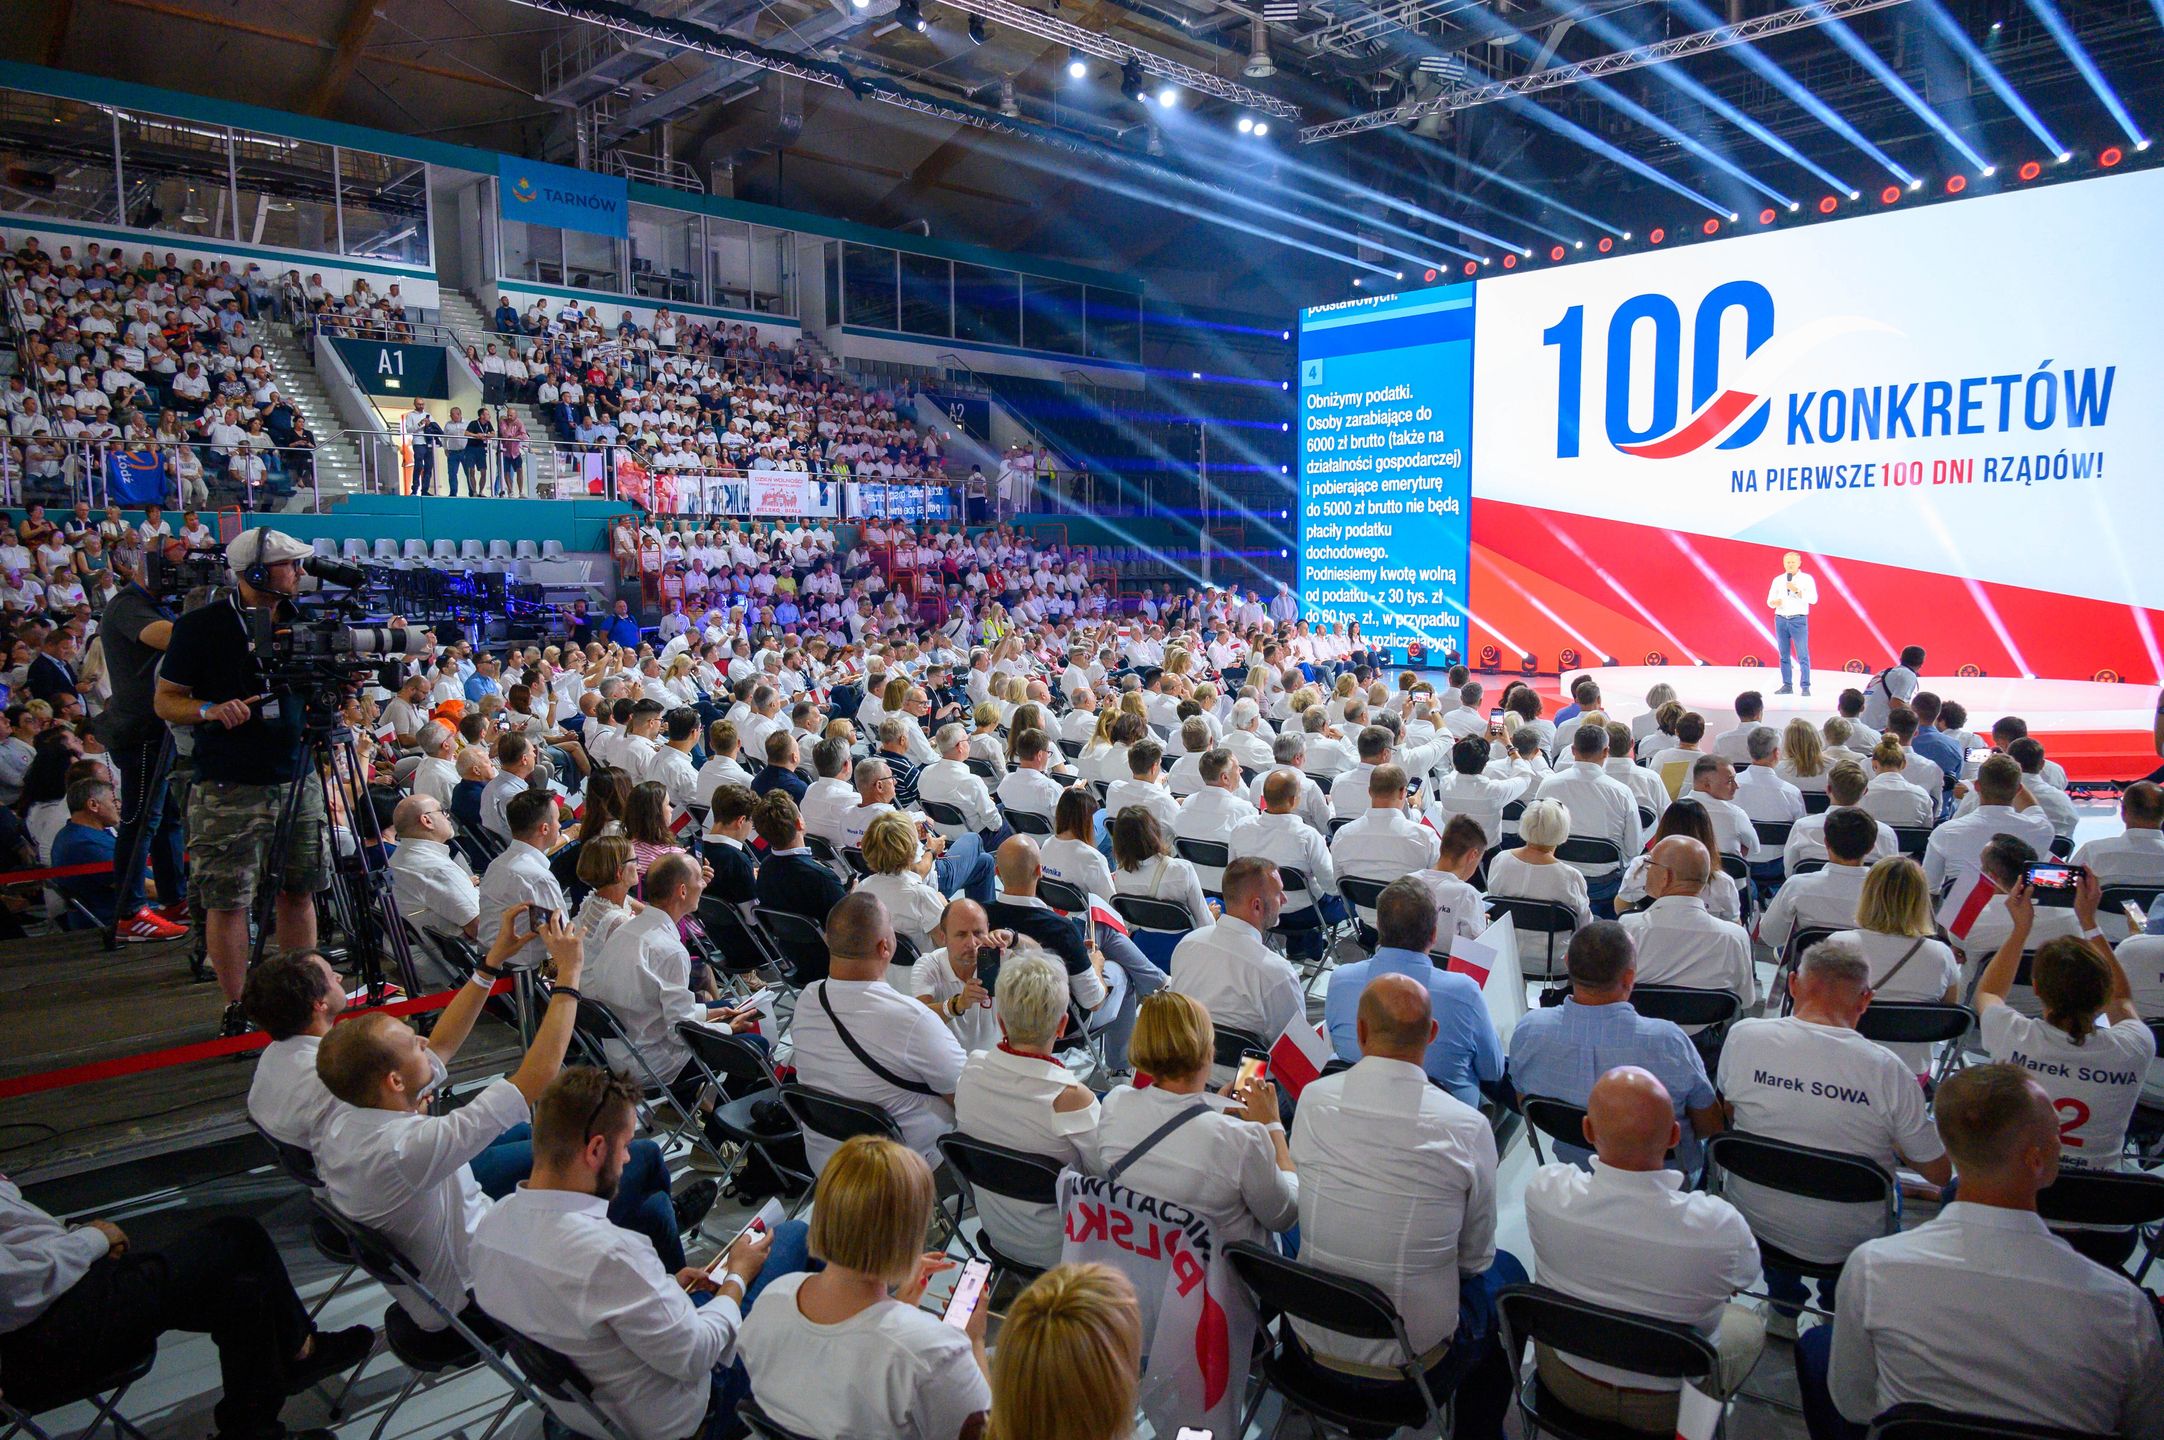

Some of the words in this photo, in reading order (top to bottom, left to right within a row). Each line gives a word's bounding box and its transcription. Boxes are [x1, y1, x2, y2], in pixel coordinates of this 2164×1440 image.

[544, 188, 616, 212] TARNÓW
[379, 349, 403, 375] A1
[1309, 366, 1317, 379] 4
[1544, 280, 1774, 458] 100
[1307, 391, 1362, 409] Obniżymy
[1366, 384, 1413, 406] podatki.
[1787, 359, 2116, 445] KONKRETÓW
[950, 403, 964, 421] A2
[1307, 414, 1342, 431] Osoby
[1346, 410, 1412, 427] zarabiające
[1416, 405, 1432, 421] do
[1307, 437, 1334, 452] 6000
[1338, 435, 1347, 450] zł
[1351, 432, 1385, 449] brutto
[1389, 430, 1424, 448] (także
[1428, 430, 1443, 442] na
[1307, 456, 1373, 474] działalności
[1376, 449, 1461, 473] gospodarczej)
[1731, 469, 1757, 493] NA
[1766, 464, 1875, 491] PIERWSZE
[1881, 462, 1923, 486] 100
[1933, 459, 1973, 485] DNI
[1983, 448, 2103, 486] RZĄDÓW!
[1306, 480, 1309, 495] i
[1313, 478, 1378, 498] pobierające
[1381, 476, 1442, 494] emeryturę
[1306, 502, 1320, 516] do
[1324, 501, 1351, 515] 5000
[1355, 500, 1365, 515] zł
[1368, 499, 1402, 514] brutto
[1406, 499, 1424, 513] nie
[1428, 496, 1459, 515] będą
[1306, 524, 1342, 540] płaciły
[1345, 522, 1392, 540] podatku
[1306, 545, 1388, 562] dochodowego.
[1306, 566, 1377, 583] Podniesiemy
[1380, 567, 1416, 583] kwotę
[1420, 566, 1456, 584] wolną
[1306, 588, 1319, 602] od
[1322, 588, 1368, 605] podatku
[1378, 592, 1385, 602] z
[1389, 589, 1403, 603] 30
[1407, 590, 1428, 606] tys.
[1432, 589, 1443, 603] zł
[1306, 609, 1319, 622] do
[1323, 609, 1336, 623] 60
[1362, 610, 1379, 626] zł.,
[1383, 614, 1393, 624] w
[1396, 612, 1459, 629] przypadku
[2011, 1051, 2069, 1078] Marek
[2078, 1068, 2137, 1084] SOWA
[1754, 1070, 1804, 1094] Marek
[1811, 1082, 1870, 1106] SOWA
[2054, 1098, 2089, 1146] 2
